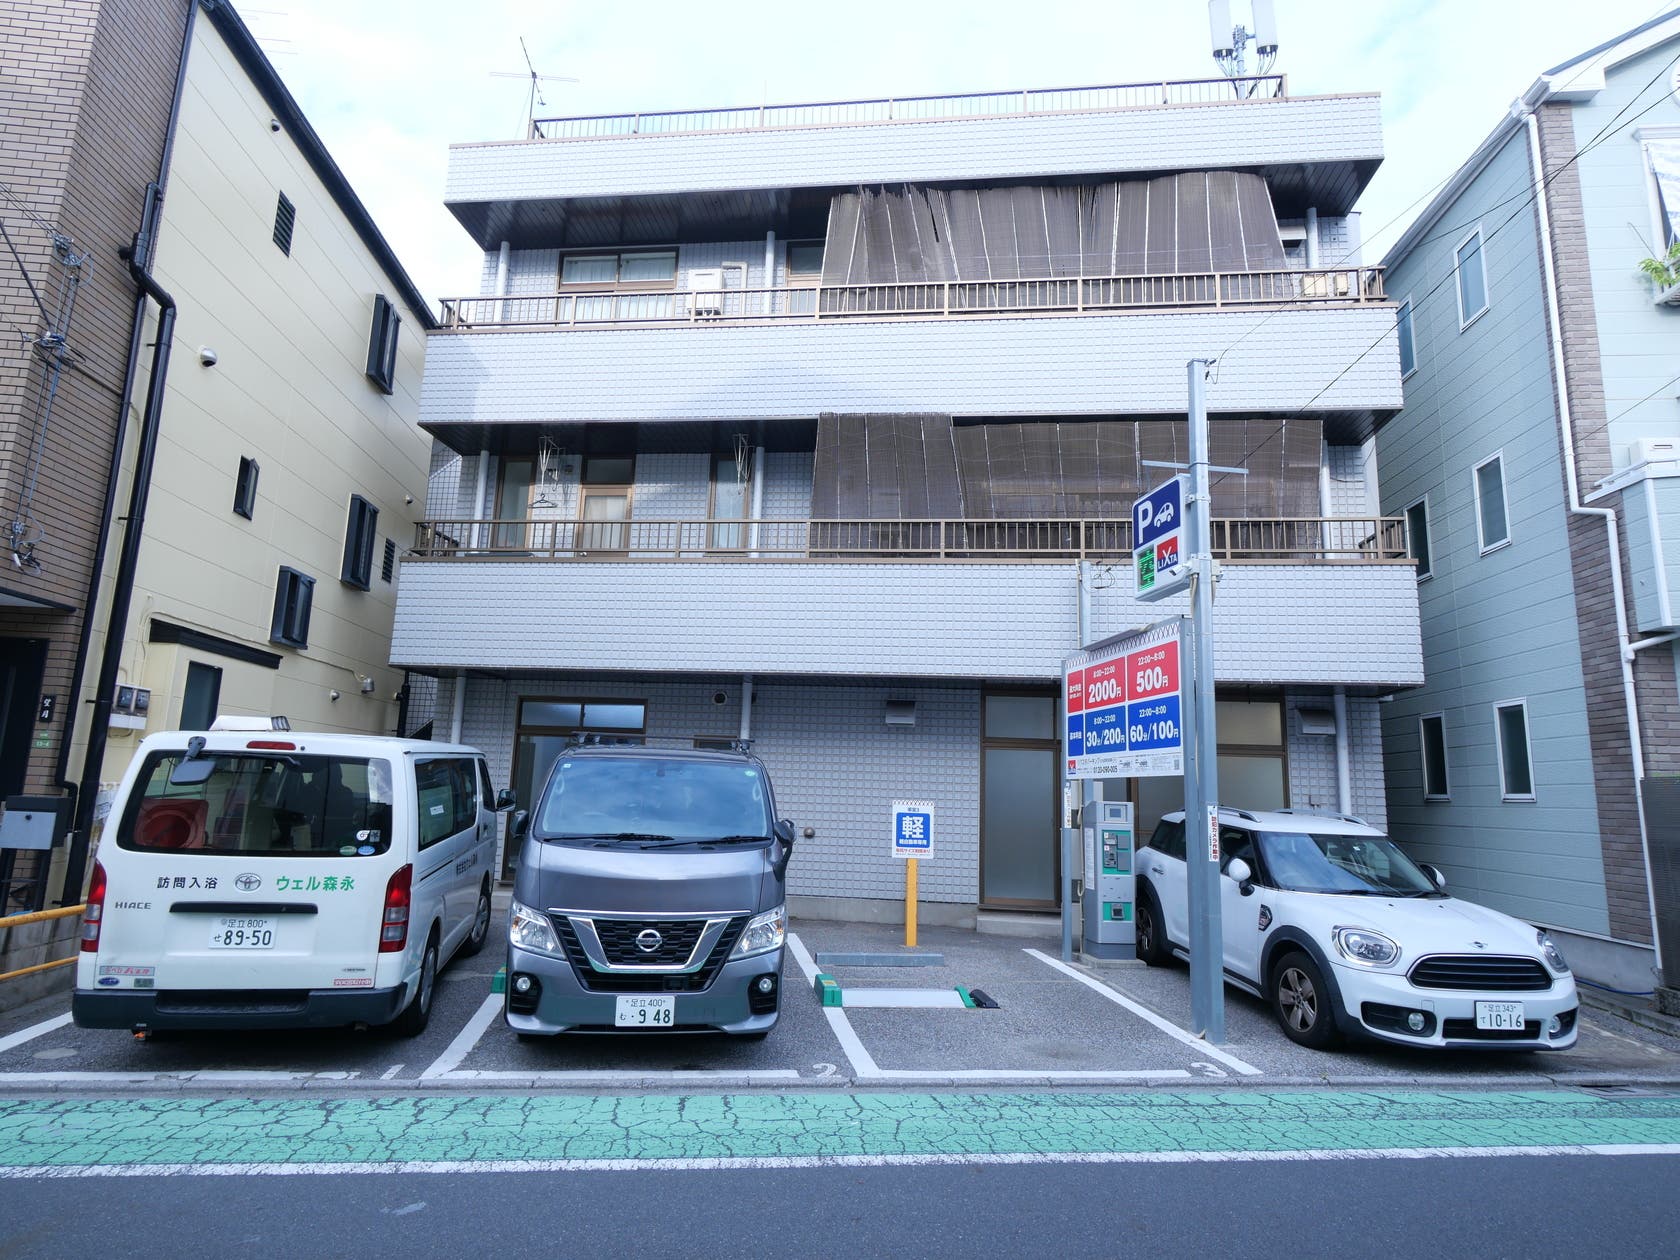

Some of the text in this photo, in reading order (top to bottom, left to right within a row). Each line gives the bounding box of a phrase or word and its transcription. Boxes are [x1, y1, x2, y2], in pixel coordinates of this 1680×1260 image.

[1138, 500, 1153, 545] P
[1136, 666, 1169, 693] 500円
[1088, 678, 1122, 704] 2000円
[1086, 727, 1125, 748] 30分/200円
[1130, 720, 1179, 743] 60分/100円
[902, 816, 924, 839] 軽
[157, 876, 218, 889] 訪問入浴
[276, 876, 355, 891] ウェル森永
[115, 902, 151, 910] HIACE
[227, 919, 264, 928] 足立 800
[223, 930, 272, 946] 89-50
[648, 999, 662, 1007] 400
[1489, 1013, 1523, 1028] 10-16
[1190, 1062, 1229, 1078] 3
